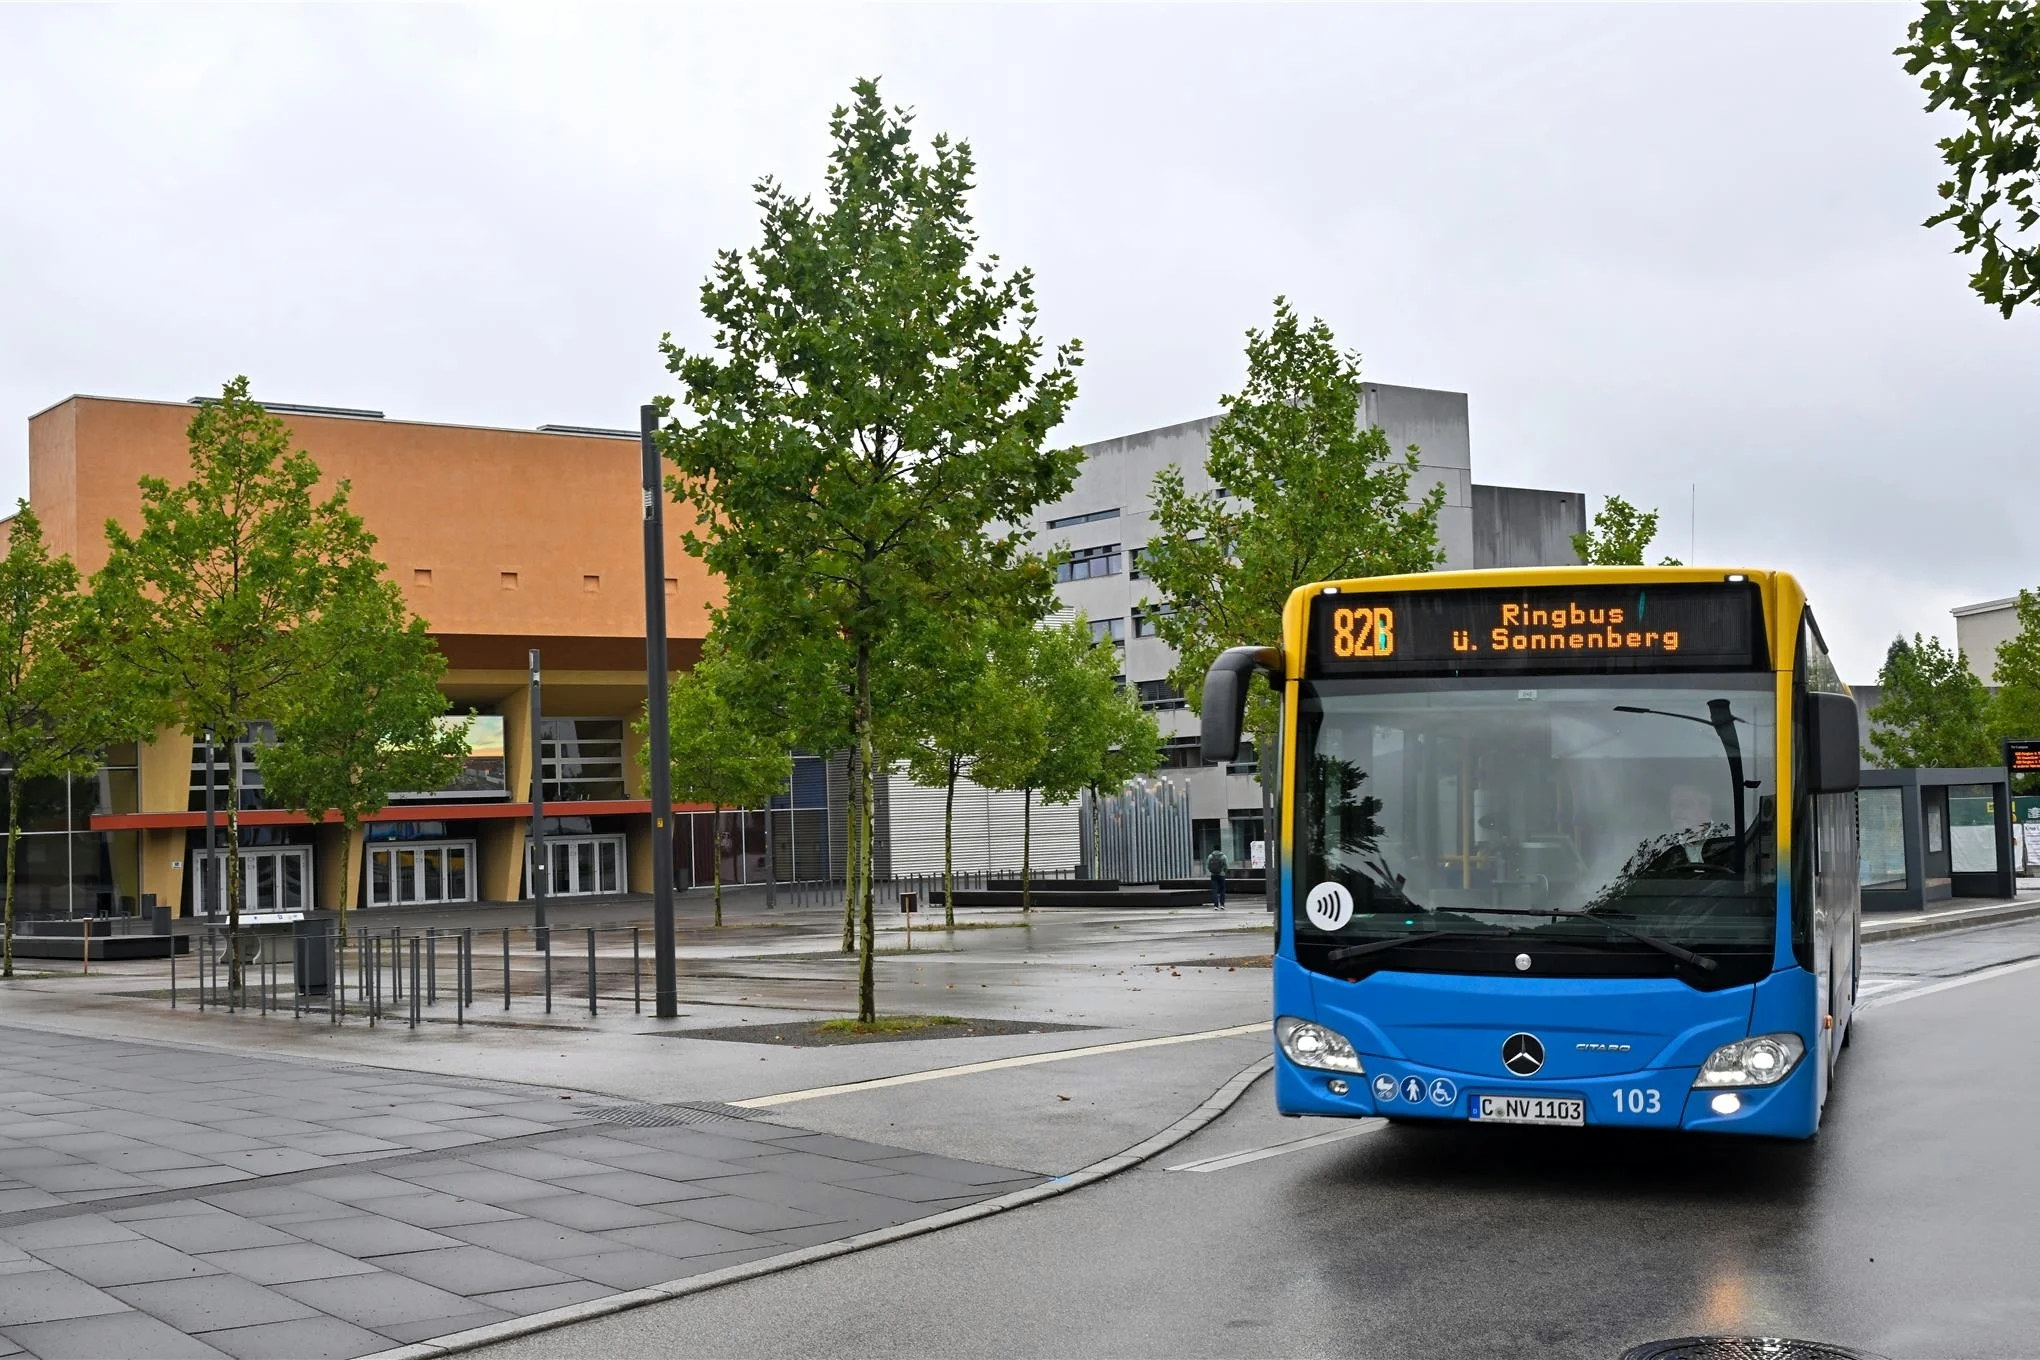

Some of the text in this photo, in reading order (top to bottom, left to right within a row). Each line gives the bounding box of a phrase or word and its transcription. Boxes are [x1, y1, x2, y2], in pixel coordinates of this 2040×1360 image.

[1502, 602, 1624, 628] Ringbus
[1333, 607, 1394, 657] 82B
[1453, 626, 1679, 651] ü. Sonnenberg
[1575, 1043, 1631, 1052] CITARO
[1482, 1098, 1581, 1120] C NV 1103
[1612, 1088, 1661, 1114] 103
